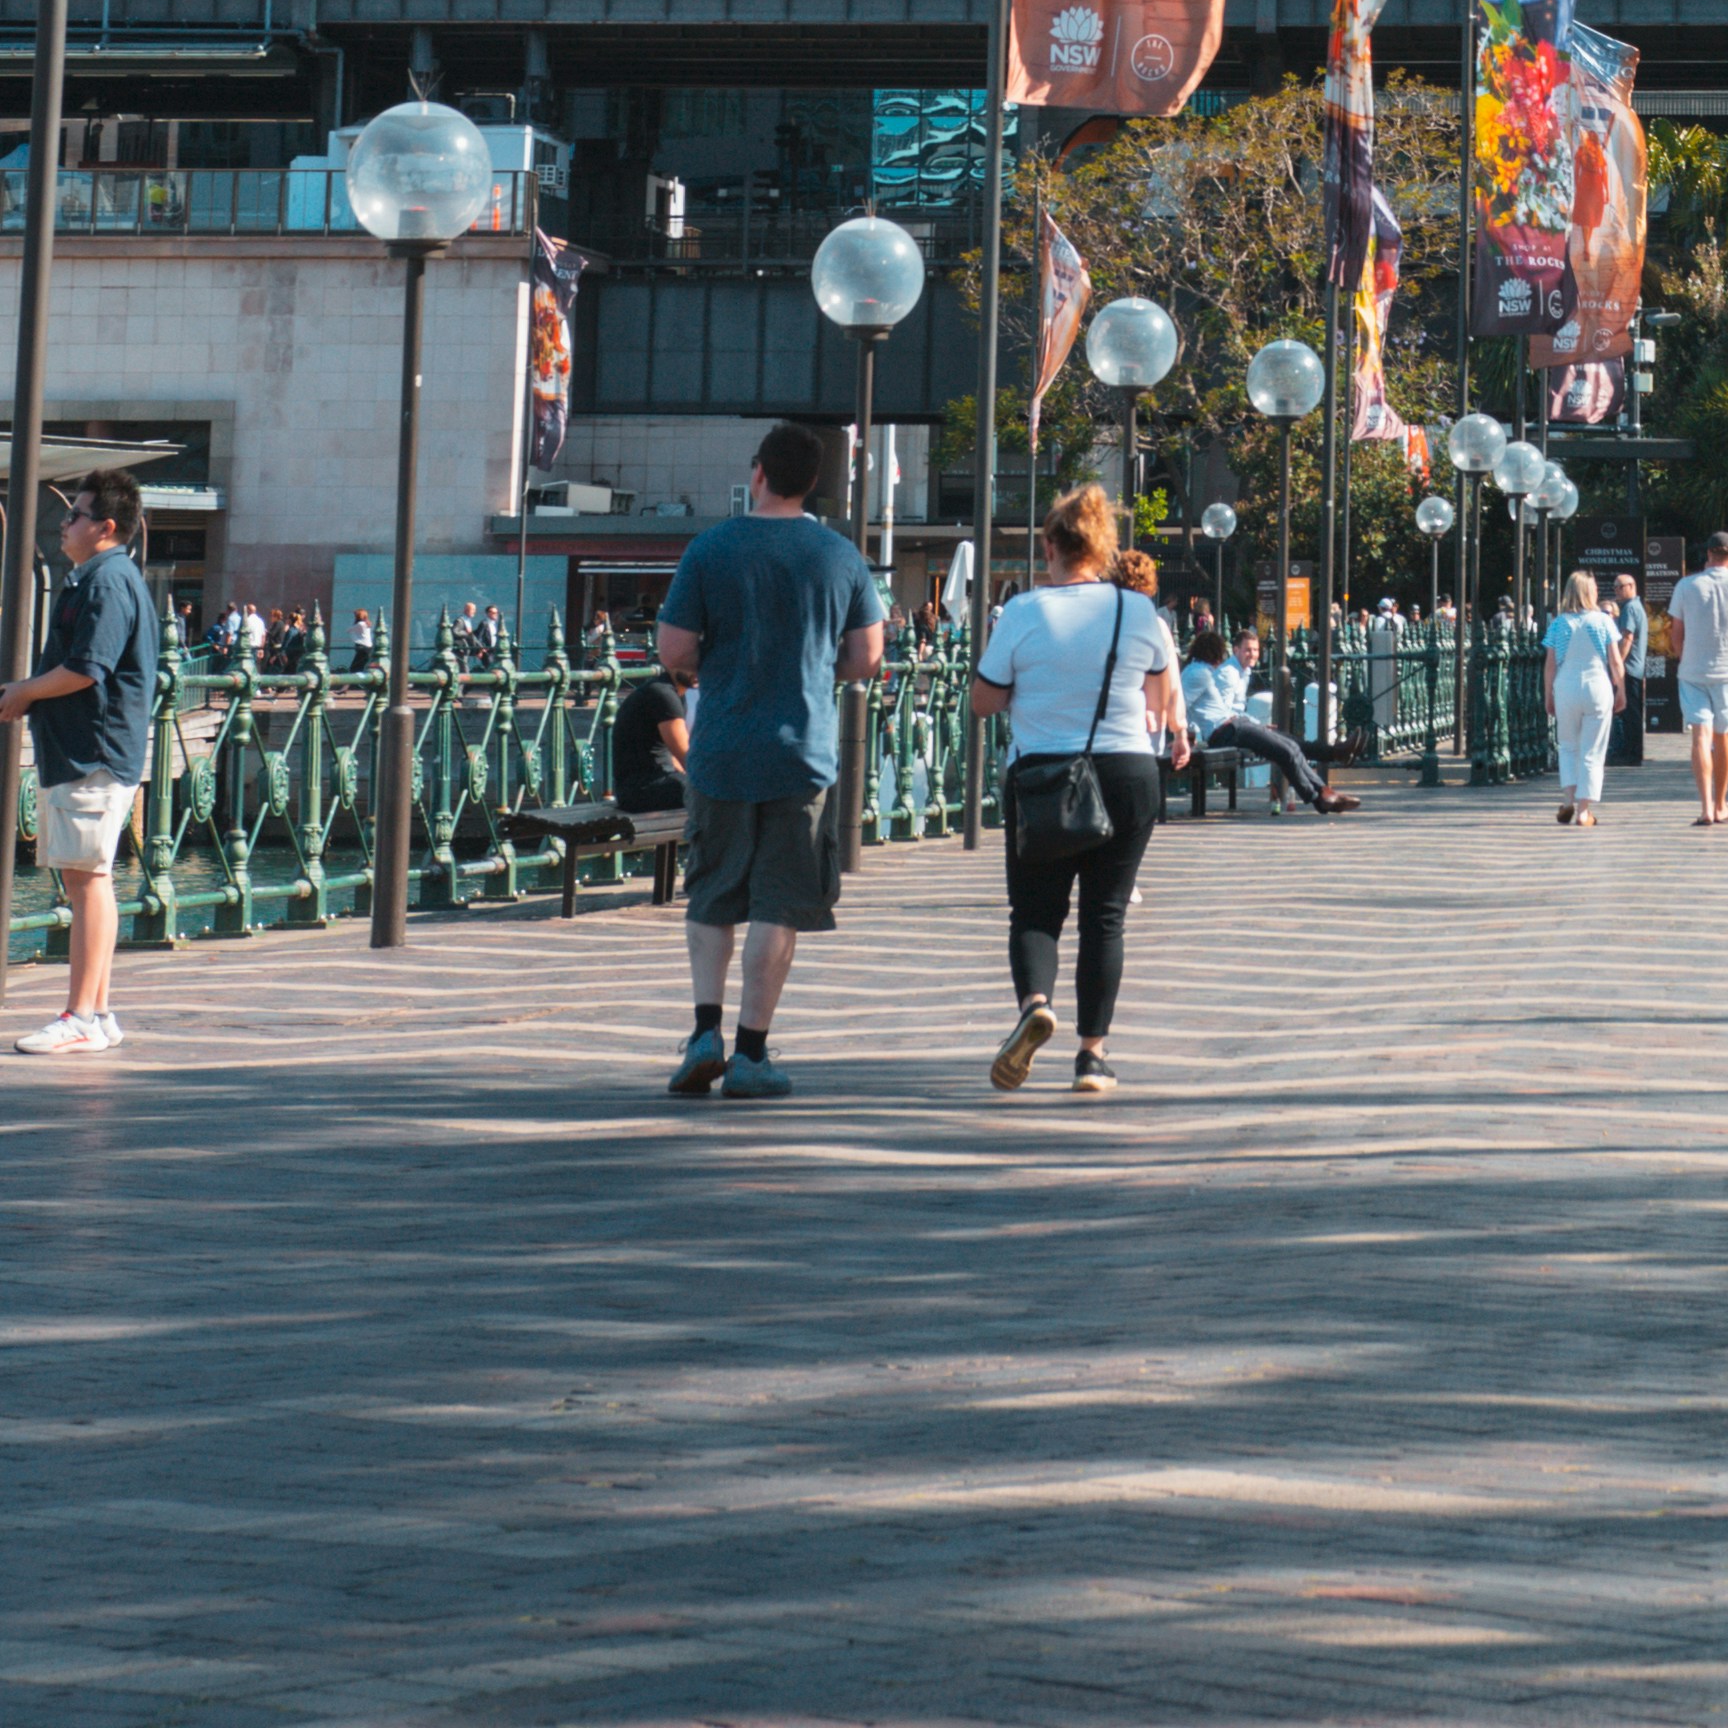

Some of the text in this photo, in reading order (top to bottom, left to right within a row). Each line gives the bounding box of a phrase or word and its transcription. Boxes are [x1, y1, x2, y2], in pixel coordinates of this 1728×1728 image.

[1050, 44, 1102, 67] NSW
[1494, 255, 1524, 267] THE
[1498, 299, 1532, 313] NSW
